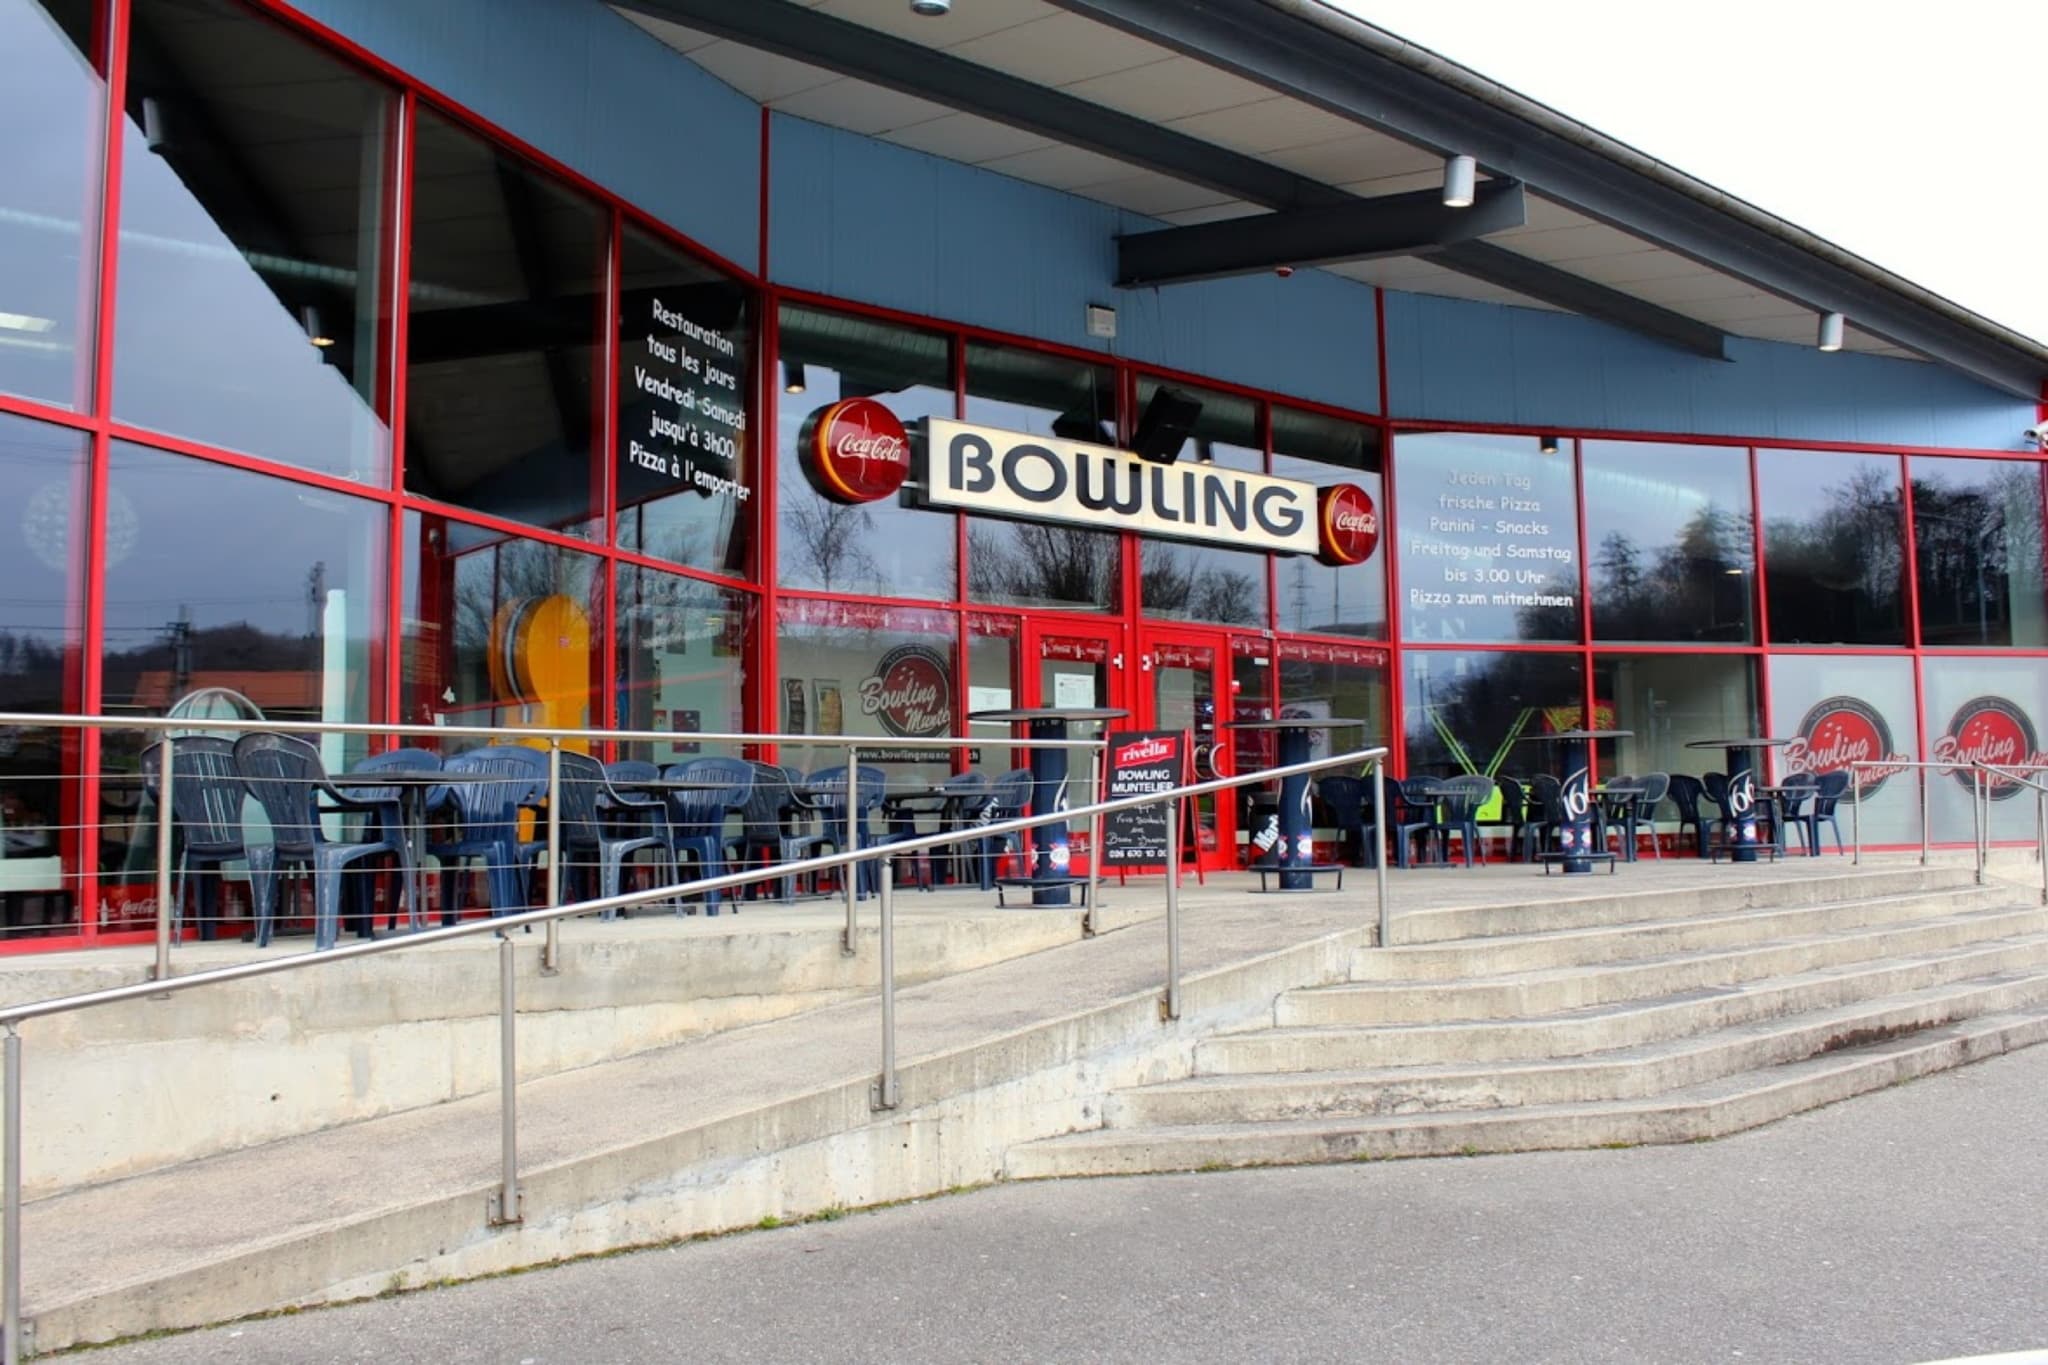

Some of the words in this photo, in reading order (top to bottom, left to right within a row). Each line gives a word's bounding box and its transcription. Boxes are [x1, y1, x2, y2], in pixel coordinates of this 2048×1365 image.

[653, 298, 734, 358] Restauration
[647, 334, 677, 364] tous
[682, 346, 700, 375] les
[704, 360, 736, 391] jours
[650, 410, 699, 447] jusqu'à
[704, 430, 736, 460] 3h00
[837, 431, 903, 462] Coca-Cola
[629, 440, 667, 474] Pizza
[671, 455, 681, 479] à
[685, 460, 751, 502] l'emporter
[1503, 473, 1532, 491] Tag
[948, 433, 1304, 538] BOWLING
[1439, 494, 1495, 511] frische
[1501, 496, 1541, 513] Pizza
[1336, 511, 1376, 535] Coca-Cola
[1430, 517, 1475, 533] Panini
[1495, 520, 1549, 536] Snacks
[1411, 540, 1470, 560] Freitag
[1474, 543, 1501, 558] und
[1506, 544, 1572, 563] Samstag
[1444, 568, 1468, 583] bis
[1474, 569, 1511, 583] 3.00
[1516, 569, 1546, 585] Uhr
[1410, 588, 1451, 606] Pizza
[1457, 593, 1487, 606] zum
[1492, 592, 1574, 608] mitnehmen
[859, 676, 937, 715] Bowling
[905, 706, 951, 733] Munte
[1122, 742, 1168, 762] rivella
[1782, 732, 1870, 775] Bowling
[1933, 731, 2015, 776] Bowling
[1118, 769, 1170, 780] BOWLING
